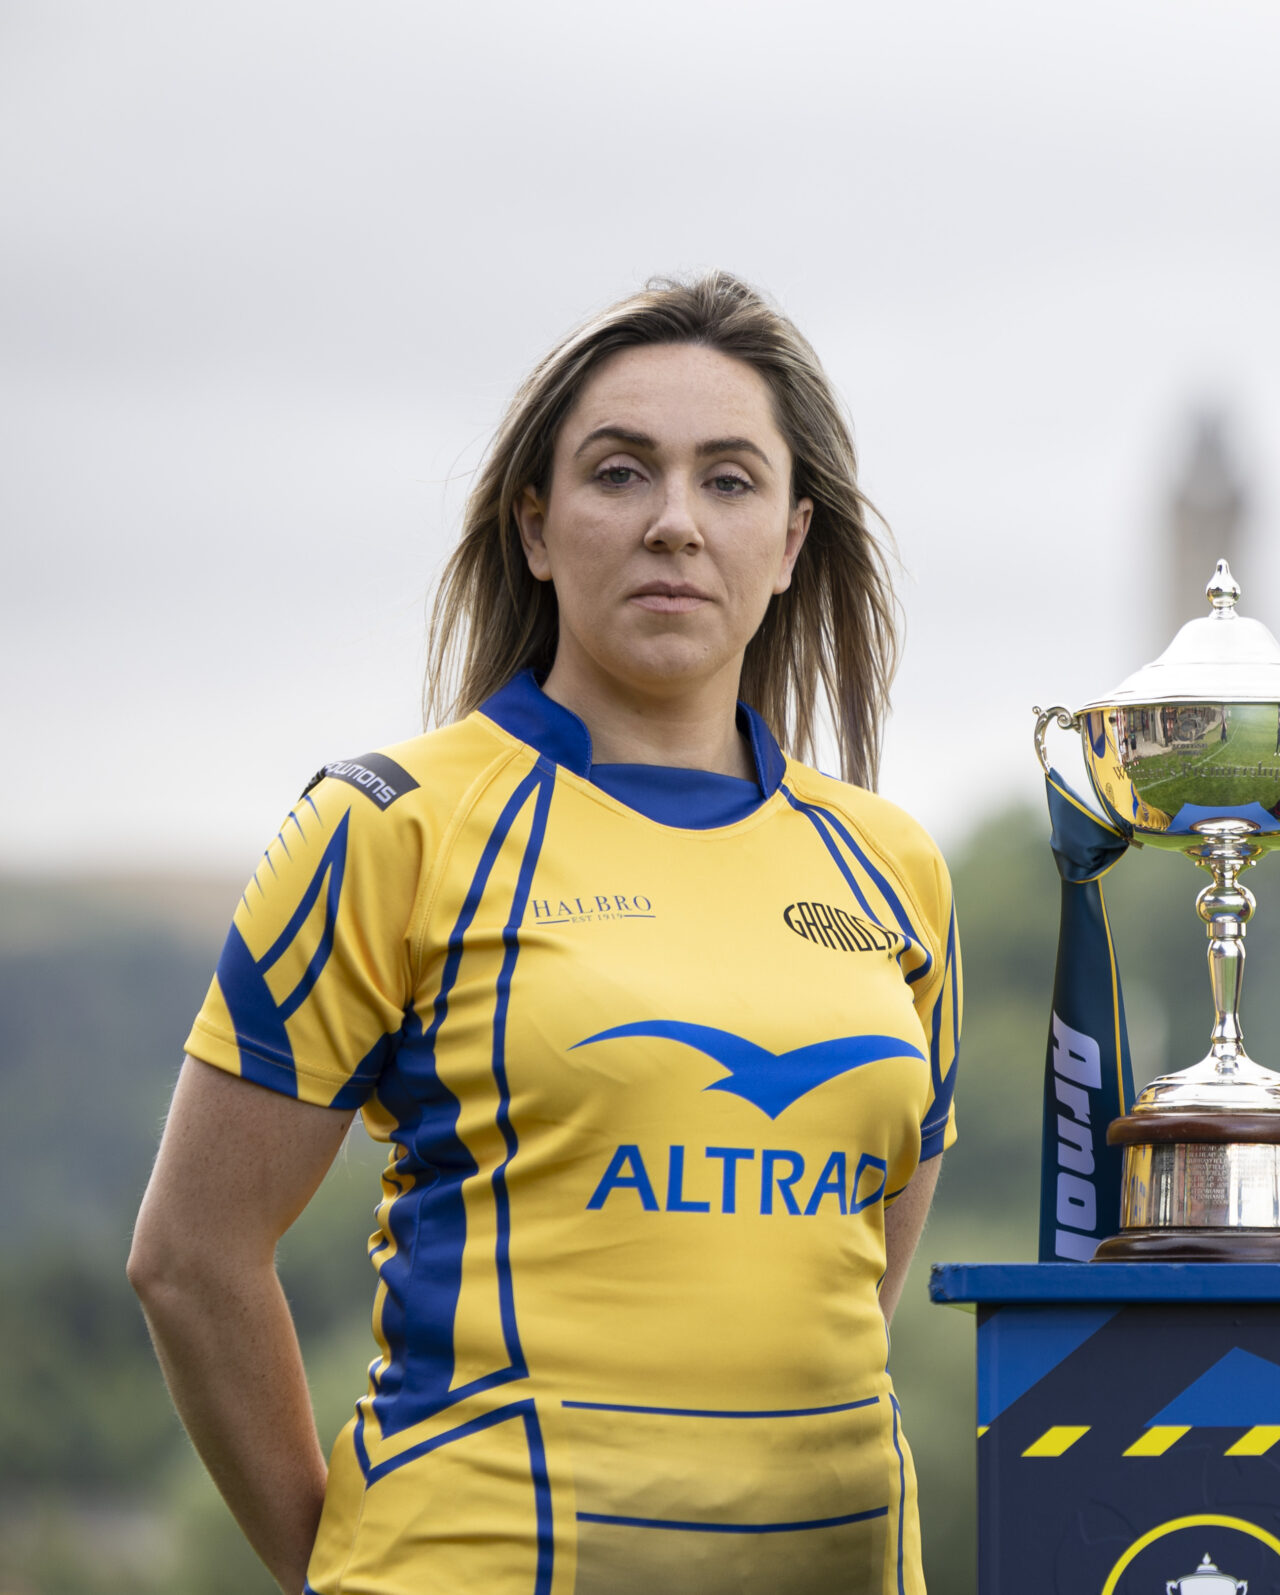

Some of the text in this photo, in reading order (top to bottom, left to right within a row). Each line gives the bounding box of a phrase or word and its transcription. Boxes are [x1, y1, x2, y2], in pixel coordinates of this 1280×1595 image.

[324, 760, 397, 804] OLUTIONS
[531, 895, 653, 918] HALBRO
[571, 914, 593, 924] EST
[585, 1144, 888, 1217] ALTRAD
